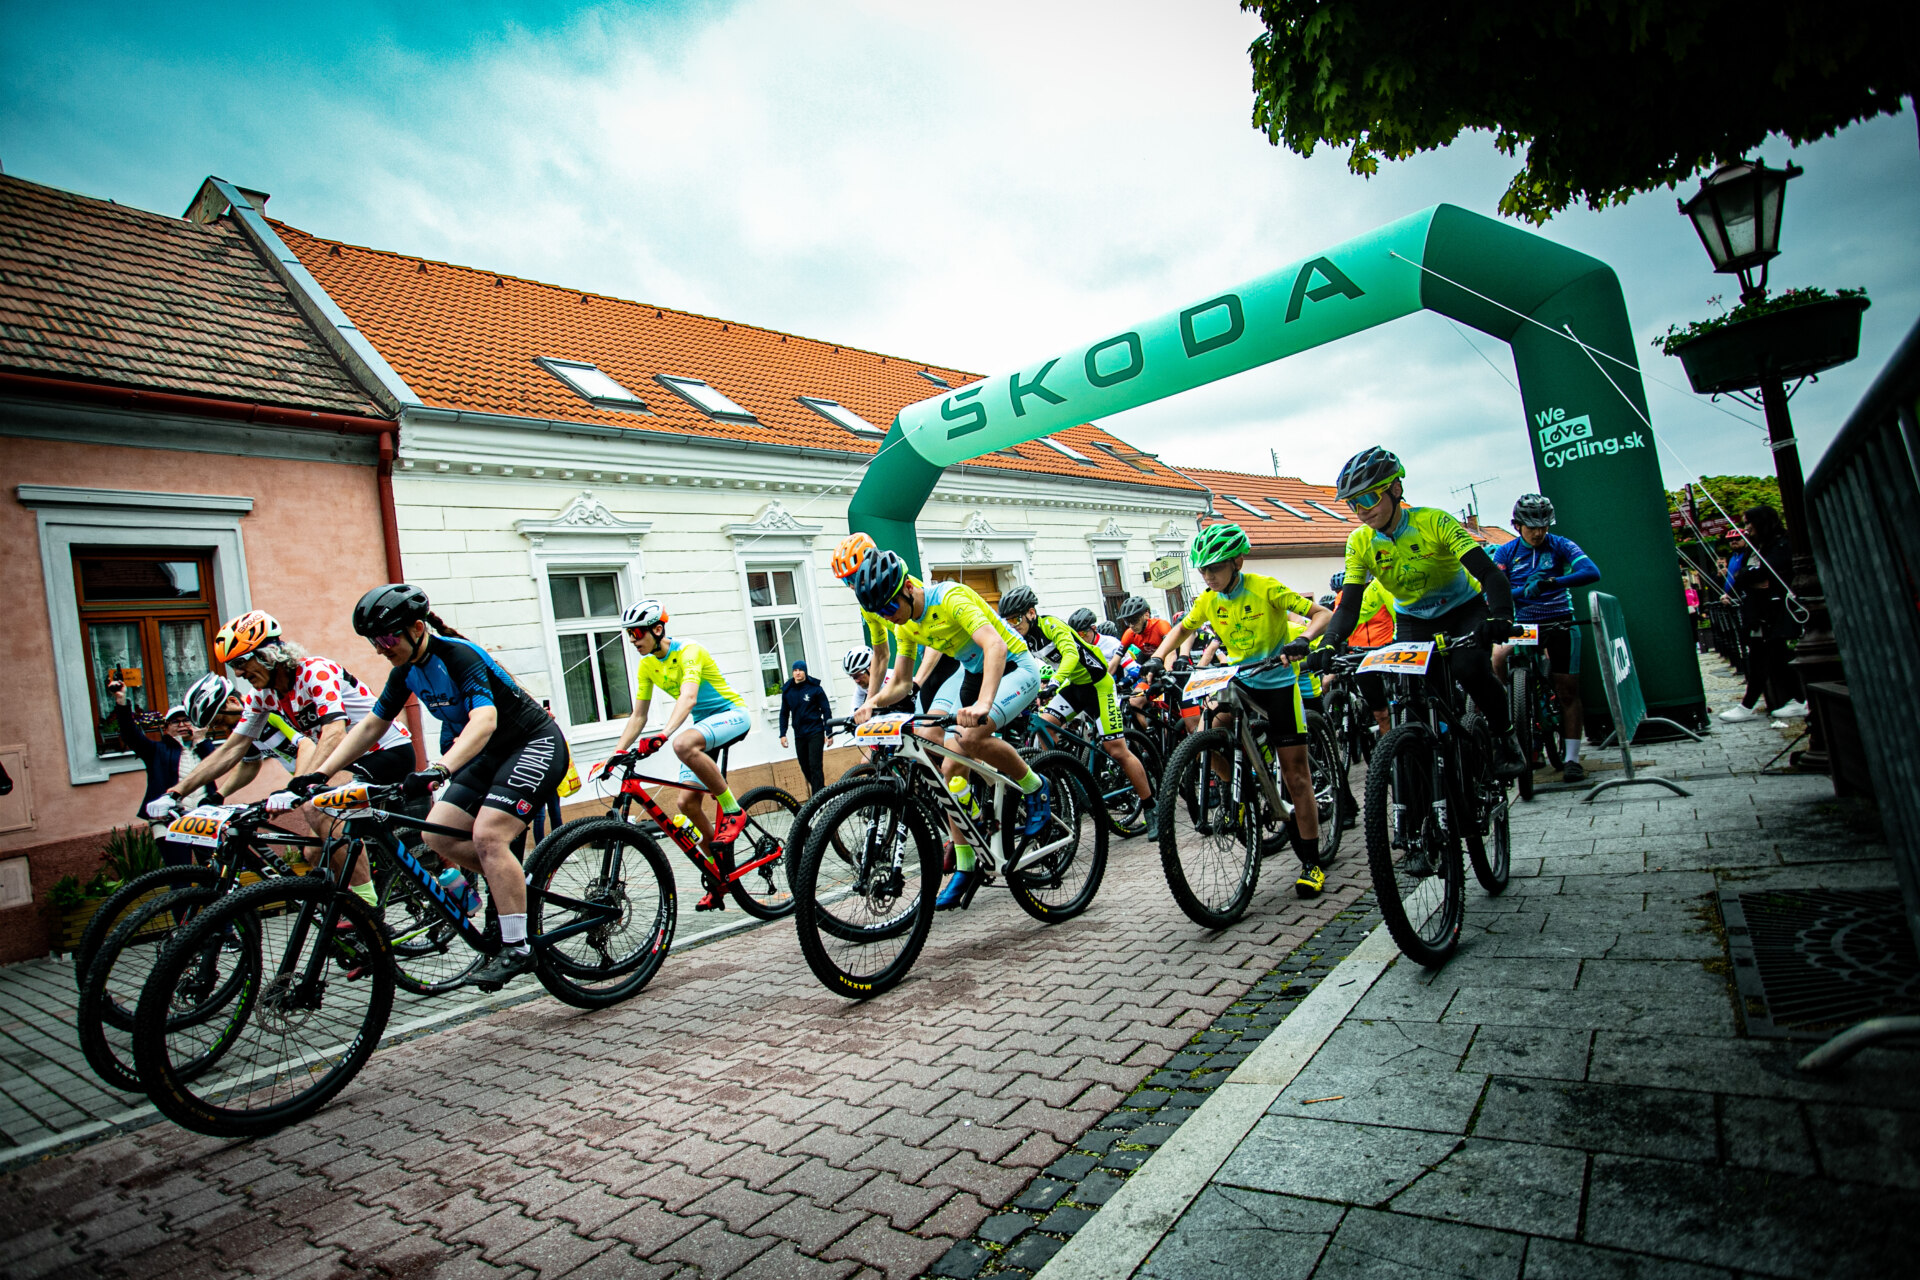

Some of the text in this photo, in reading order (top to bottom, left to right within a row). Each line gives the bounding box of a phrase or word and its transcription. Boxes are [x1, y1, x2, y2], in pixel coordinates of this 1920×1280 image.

[1534, 407, 1566, 428] We
[1543, 431, 1646, 468] Cycling.sk
[1371, 651, 1417, 666] 842
[1106, 693, 1118, 731] KAKTUS
[863, 721, 894, 735] 925
[508, 735, 555, 793] SLOVAKIA
[322, 788, 361, 808] 905
[173, 816, 218, 837] 1003
[838, 975, 872, 991] MAXXIS
